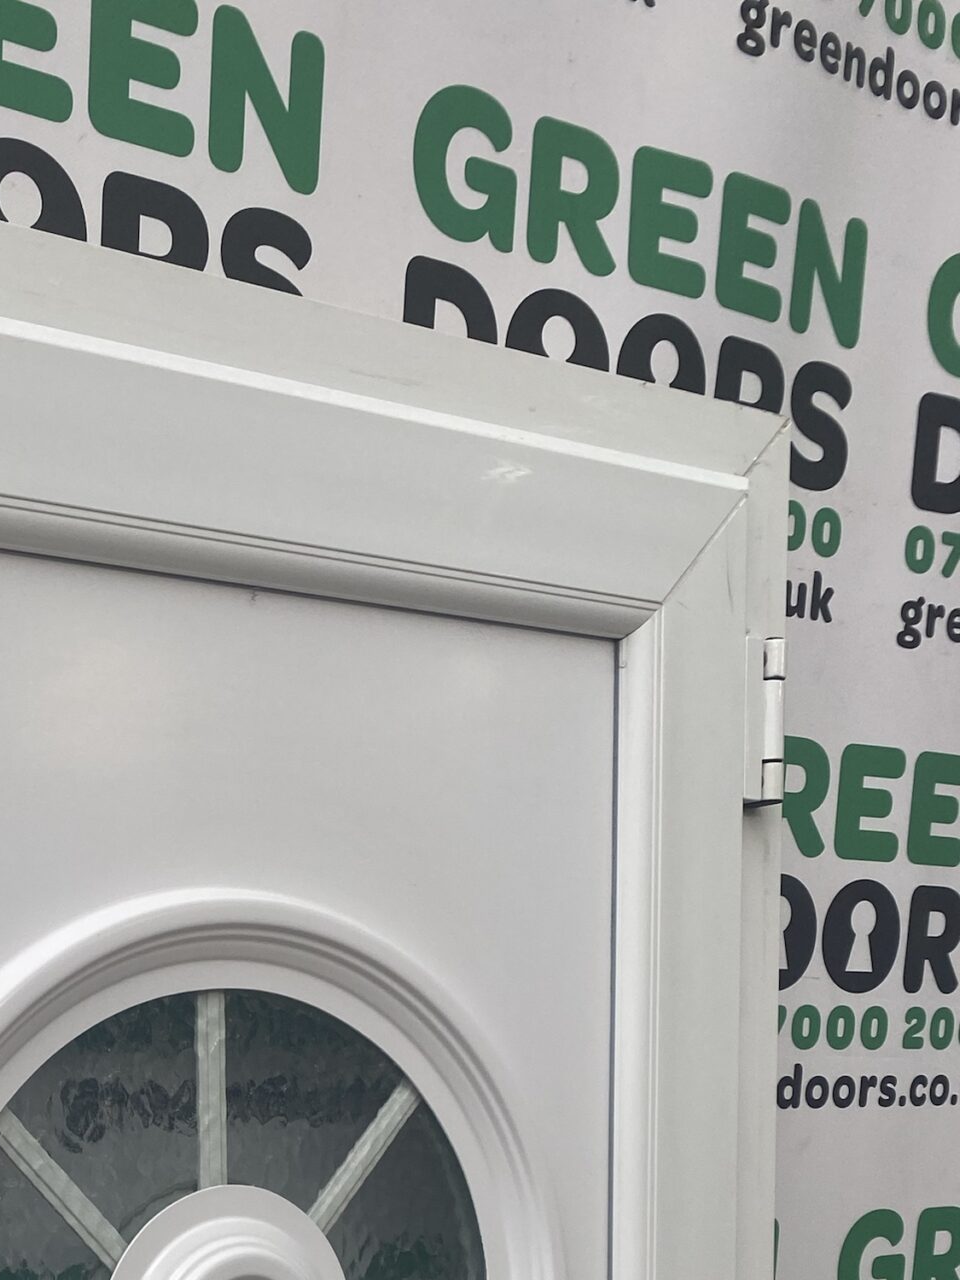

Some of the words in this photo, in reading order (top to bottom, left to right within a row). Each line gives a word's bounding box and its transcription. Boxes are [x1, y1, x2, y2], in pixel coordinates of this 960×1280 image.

[413, 84, 868, 349] GREEN
[778, 1004, 888, 1050] 000
[902, 1006, 960, 1050] 20
